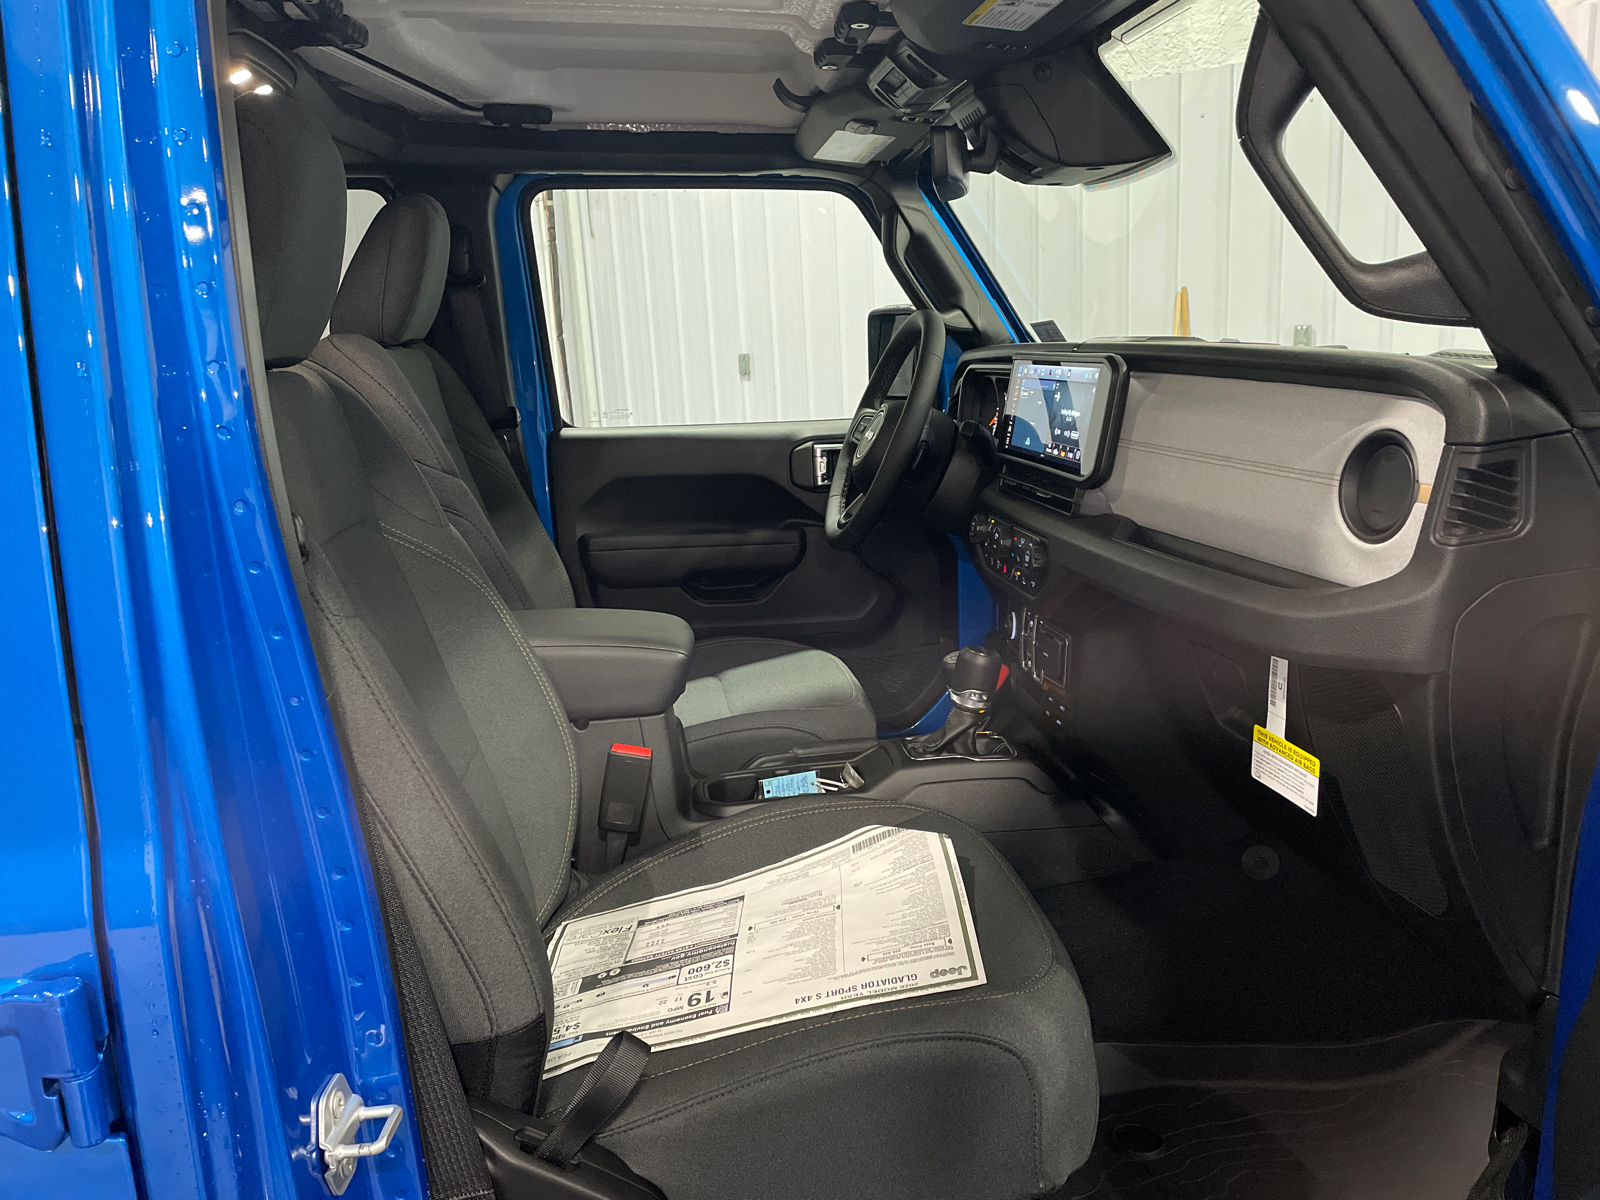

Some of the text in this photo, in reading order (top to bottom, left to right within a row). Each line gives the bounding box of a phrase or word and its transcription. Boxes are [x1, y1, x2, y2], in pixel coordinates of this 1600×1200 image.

[1257, 729, 1317, 767] THIS VEHICLE IS EQUIPPED
[1257, 736, 1316, 774] WITH ADVANCED AIR BAGS
[688, 958, 731, 975] $2,600
[929, 964, 968, 980] Jeep
[684, 973, 704, 982] cost
[860, 973, 918, 990] GLADIATOR
[824, 985, 858, 998] SPORT
[866, 986, 898, 995] MODEL
[898, 982, 918, 990] 2026
[686, 990, 715, 1008] 19
[794, 995, 813, 1005] 4X4
[815, 992, 822, 1000] S
[667, 1005, 684, 1013] MPG
[698, 1009, 713, 1018] Fuel
[666, 1013, 697, 1024] Economy
[553, 1022, 582, 1036] $4,5
[650, 1021, 664, 1029] and
